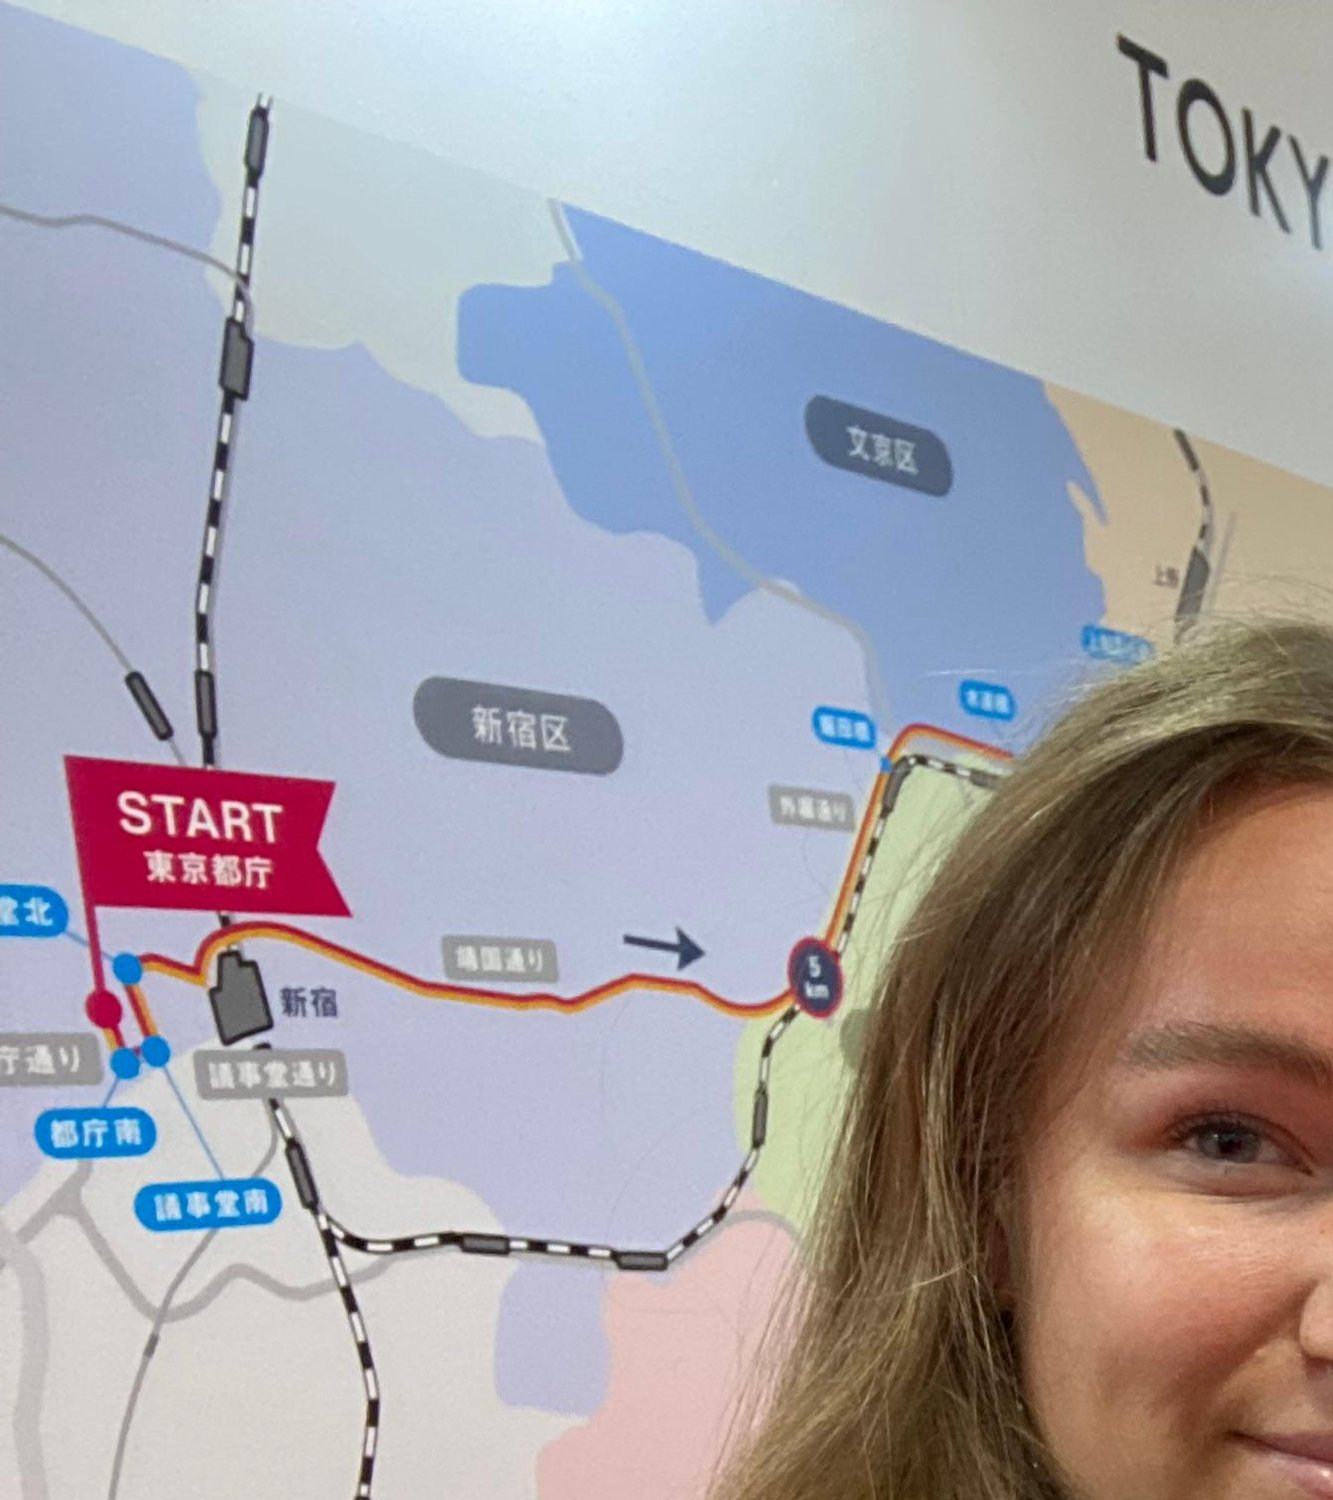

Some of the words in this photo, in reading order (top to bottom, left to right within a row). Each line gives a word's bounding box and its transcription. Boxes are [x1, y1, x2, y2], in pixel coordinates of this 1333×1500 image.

[846, 425, 919, 476] 文京区
[471, 704, 571, 751] 新宿区
[117, 791, 283, 844] START
[143, 850, 272, 889] 東京都庁
[280, 987, 338, 1018] 新宿
